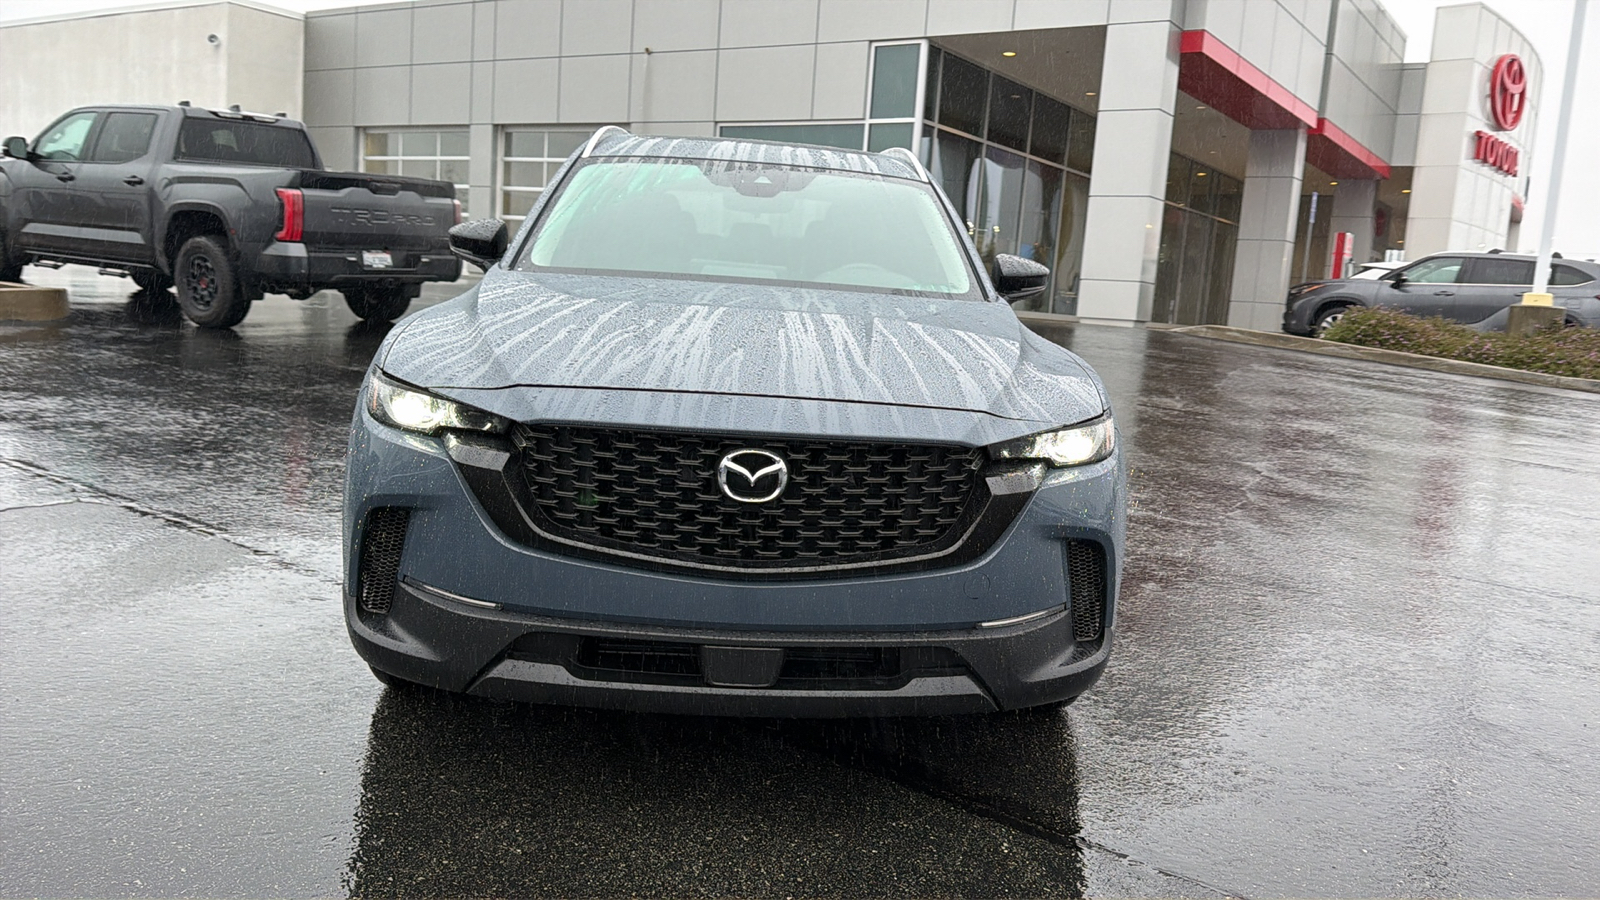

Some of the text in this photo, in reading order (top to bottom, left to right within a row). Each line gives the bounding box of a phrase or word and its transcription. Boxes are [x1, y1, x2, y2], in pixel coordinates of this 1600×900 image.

[1474, 131, 1518, 177] TOYOTA
[331, 208, 436, 226] TRD PRO
